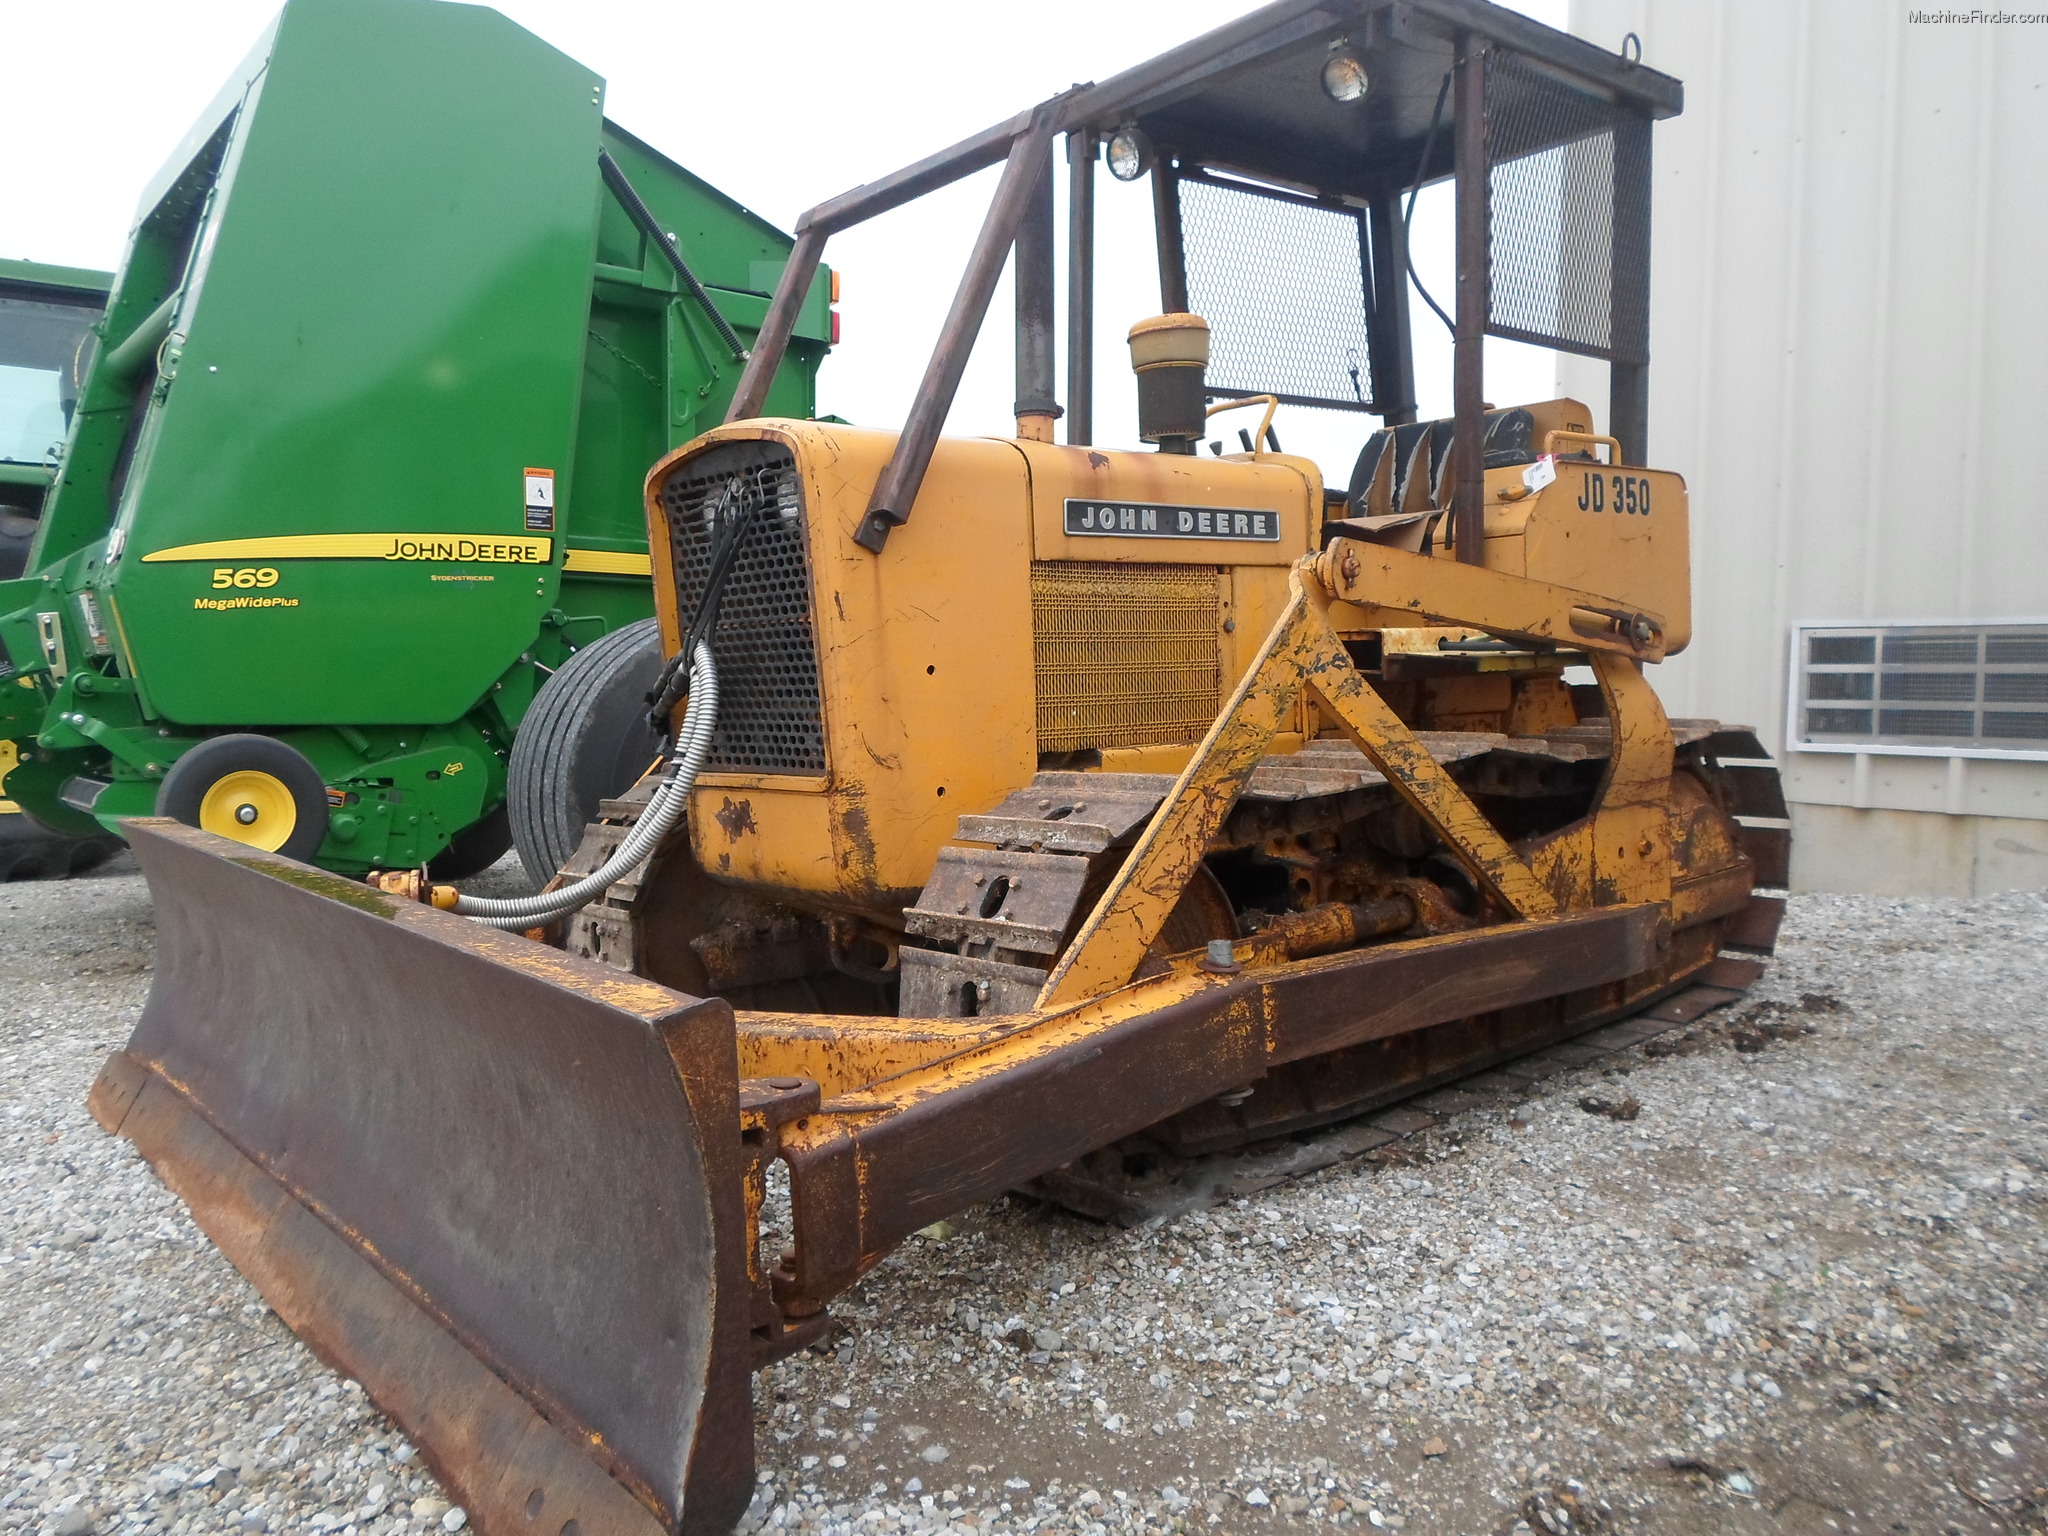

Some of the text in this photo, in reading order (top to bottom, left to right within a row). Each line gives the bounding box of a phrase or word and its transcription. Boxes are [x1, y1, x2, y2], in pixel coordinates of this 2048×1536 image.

[1578, 472, 1605, 513] JD
[1612, 475, 1650, 516] 350
[1081, 507, 1266, 535] JOHN DEERE
[385, 538, 538, 561] JOHN DEERE
[211, 567, 280, 589] 569
[194, 596, 299, 611] MegaWidePlus
